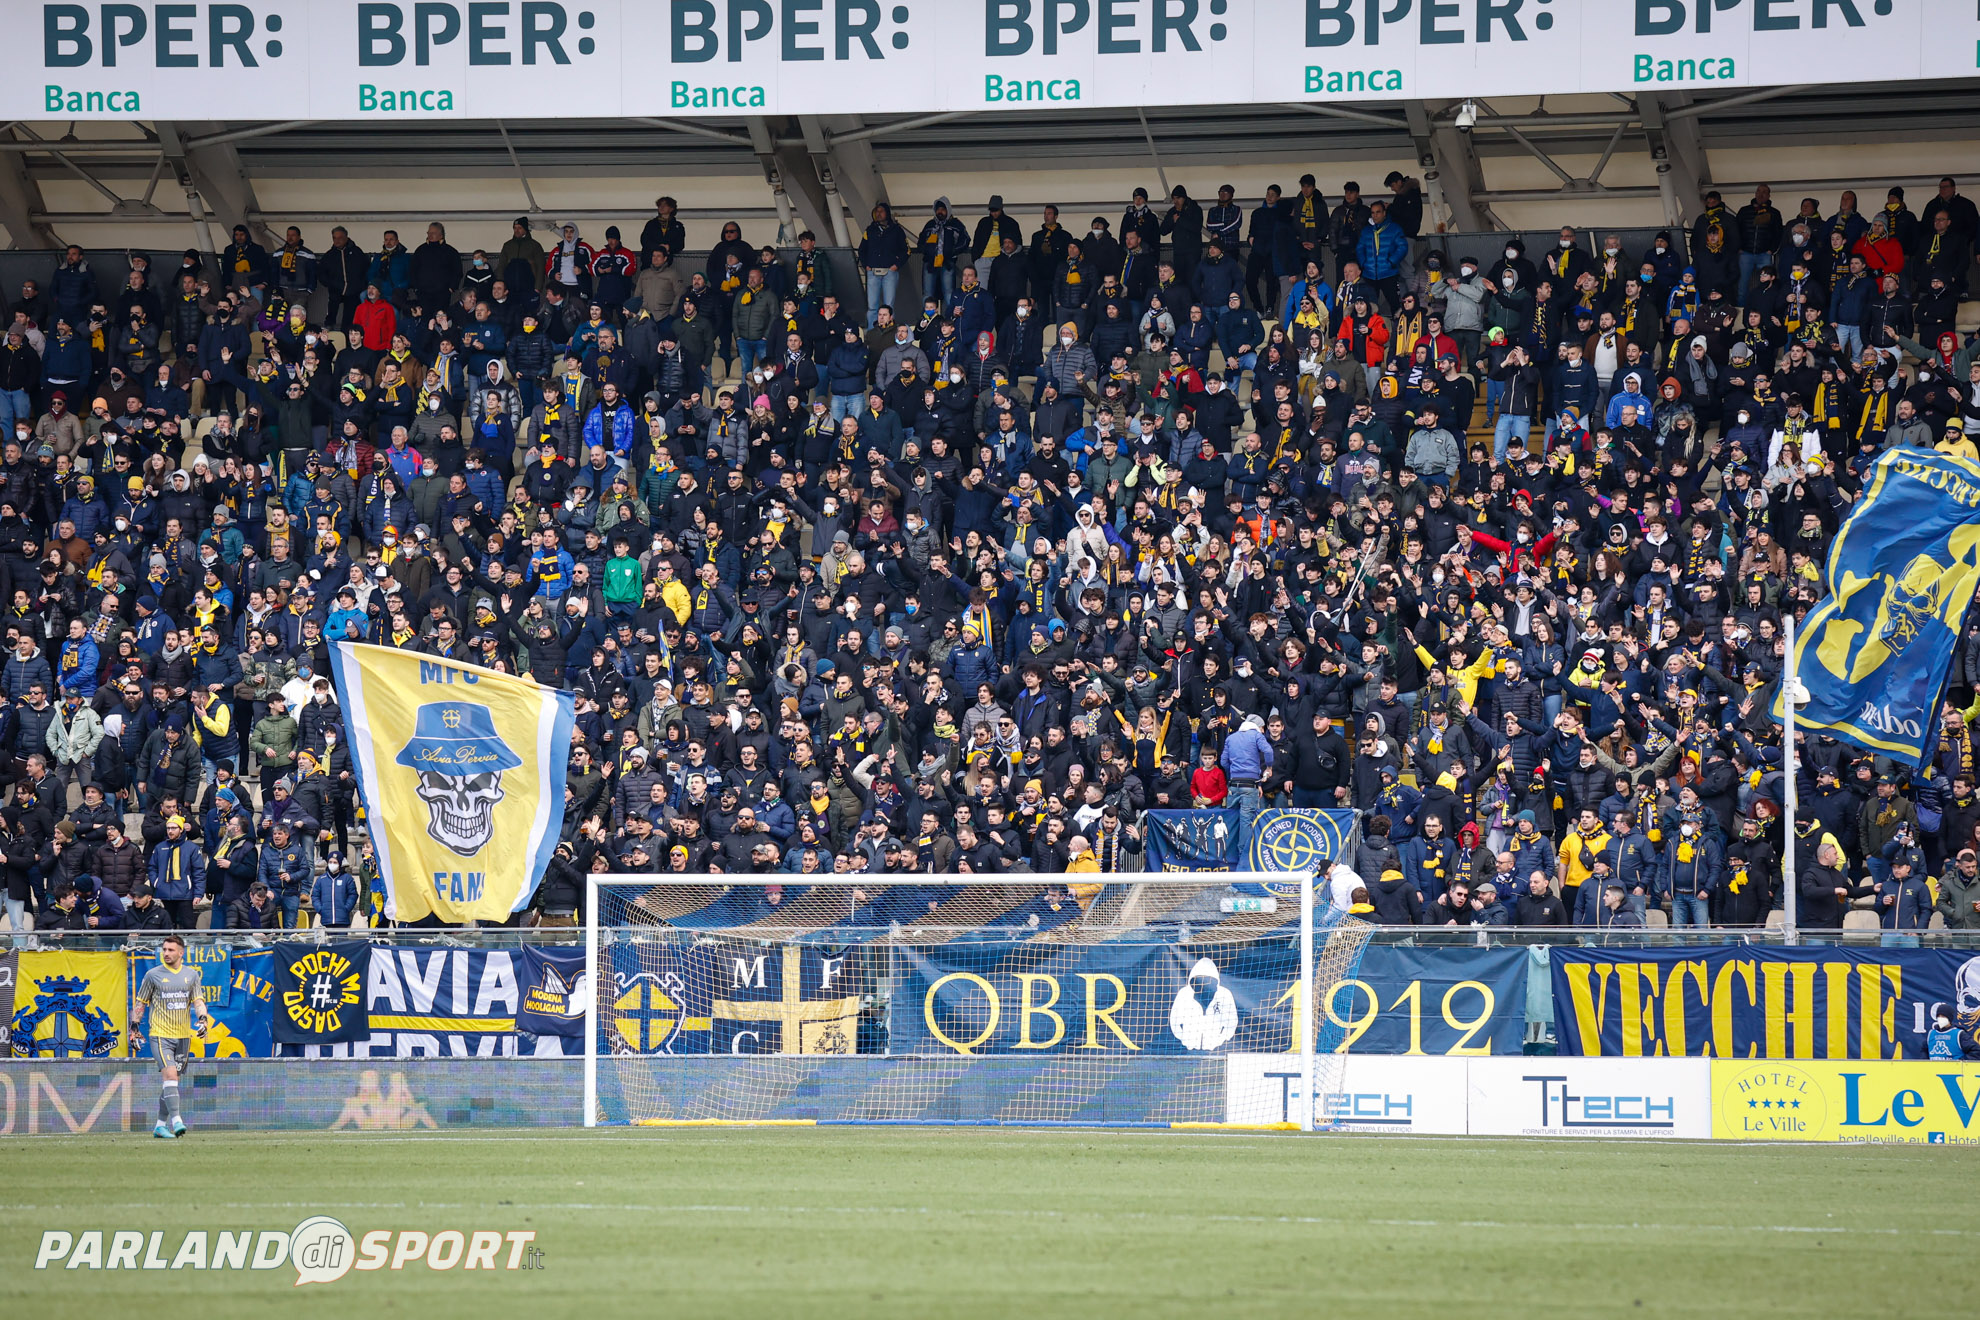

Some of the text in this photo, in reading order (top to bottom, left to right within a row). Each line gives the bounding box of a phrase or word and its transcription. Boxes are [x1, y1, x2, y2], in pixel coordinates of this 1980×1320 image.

[1304, 66, 1402, 93] Banca
[1634, 54, 1735, 83] Banca
[44, 85, 141, 112] Banca
[359, 84, 454, 111] Banca
[671, 81, 766, 107] Banca
[985, 75, 1081, 102] Banca
[1265, 821, 1292, 841] STONED
[1301, 822, 1325, 850] MODENA
[1263, 848, 1281, 872] ODENA
[289, 951, 351, 981] POCHI
[368, 948, 519, 1015] AVIA
[525, 999, 566, 1014] HOOLIGANS
[532, 989, 562, 1004] MODENA
[1564, 959, 1903, 1059] VECCHIE
[924, 972, 1494, 1056] QBR 1912
[1738, 1073, 1808, 1094] HOTEL
[0, 1070, 132, 1134] M
[1838, 1073, 1925, 1127] Le
[1743, 1116, 1806, 1132] Le Ville
[1839, 1134, 1924, 1144] hotellevilleeu
